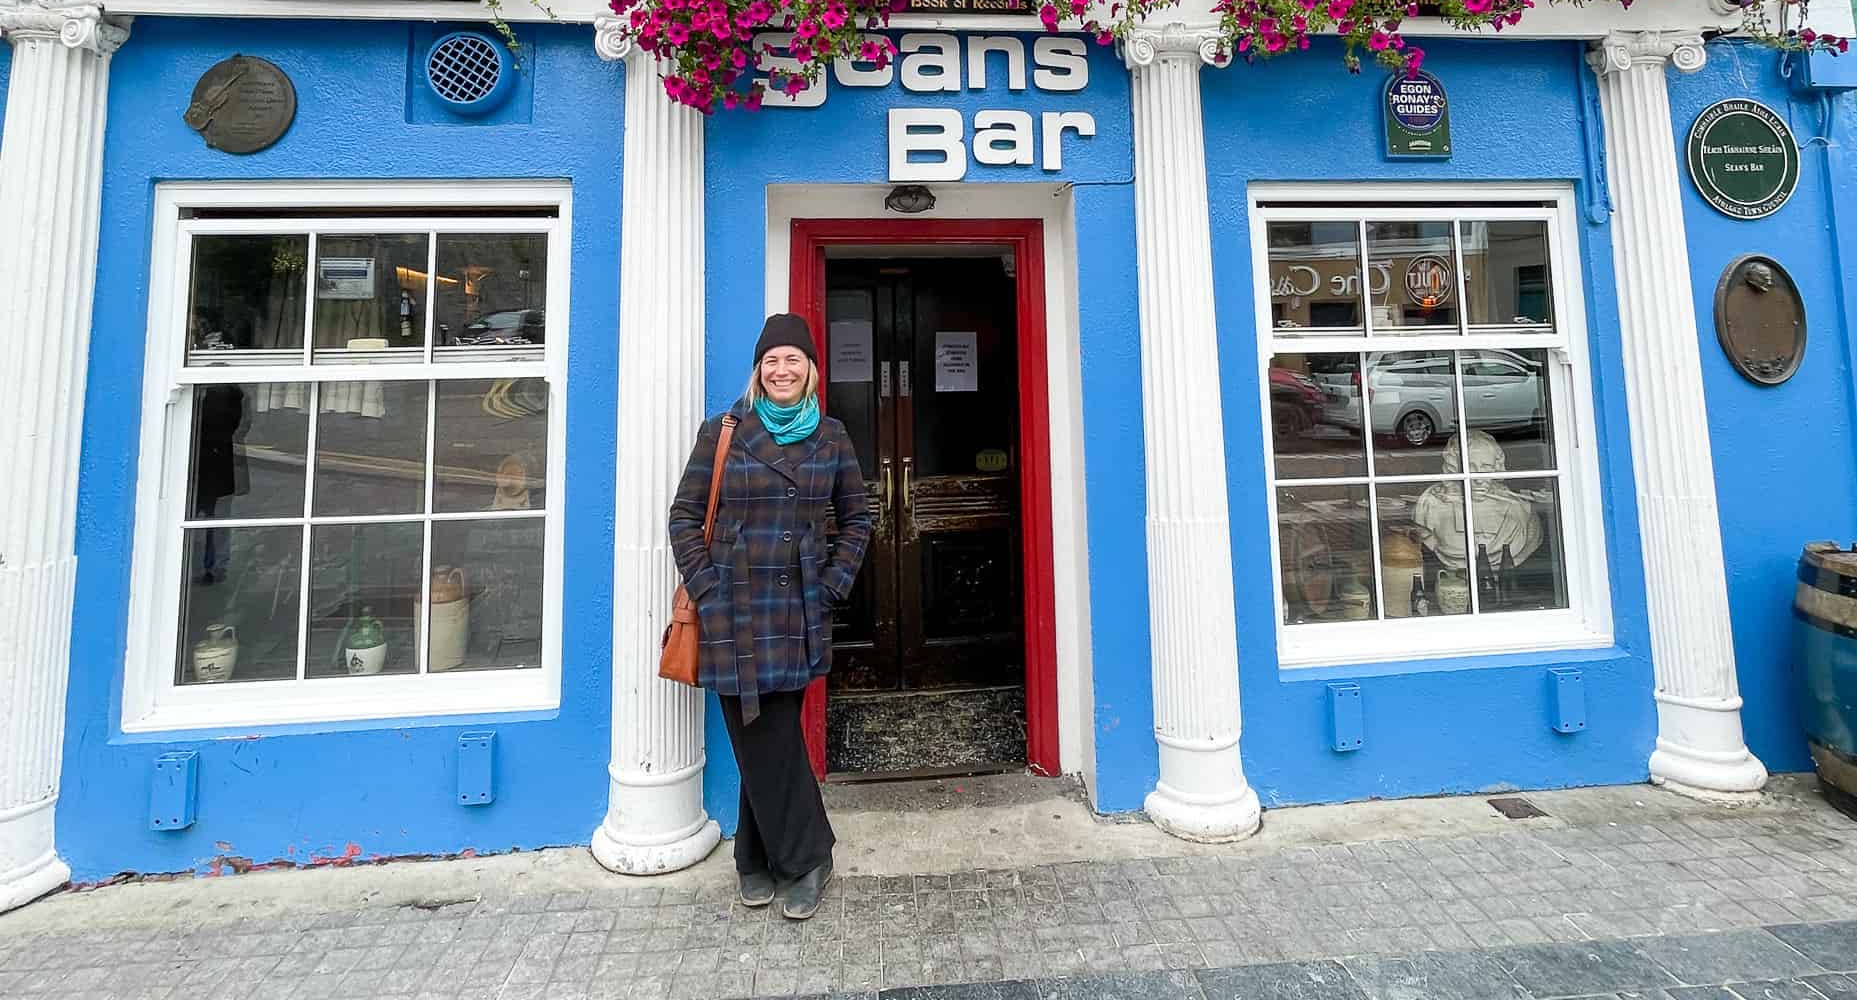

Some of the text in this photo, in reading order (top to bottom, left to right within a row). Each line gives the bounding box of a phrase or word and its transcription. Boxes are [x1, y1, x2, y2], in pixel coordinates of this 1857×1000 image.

[752, 31, 1089, 108] Seans
[1400, 84, 1431, 94] EGON
[1392, 94, 1441, 105] RONAY'S
[1396, 104, 1438, 114] GUIDES
[888, 108, 1096, 182] Bar
